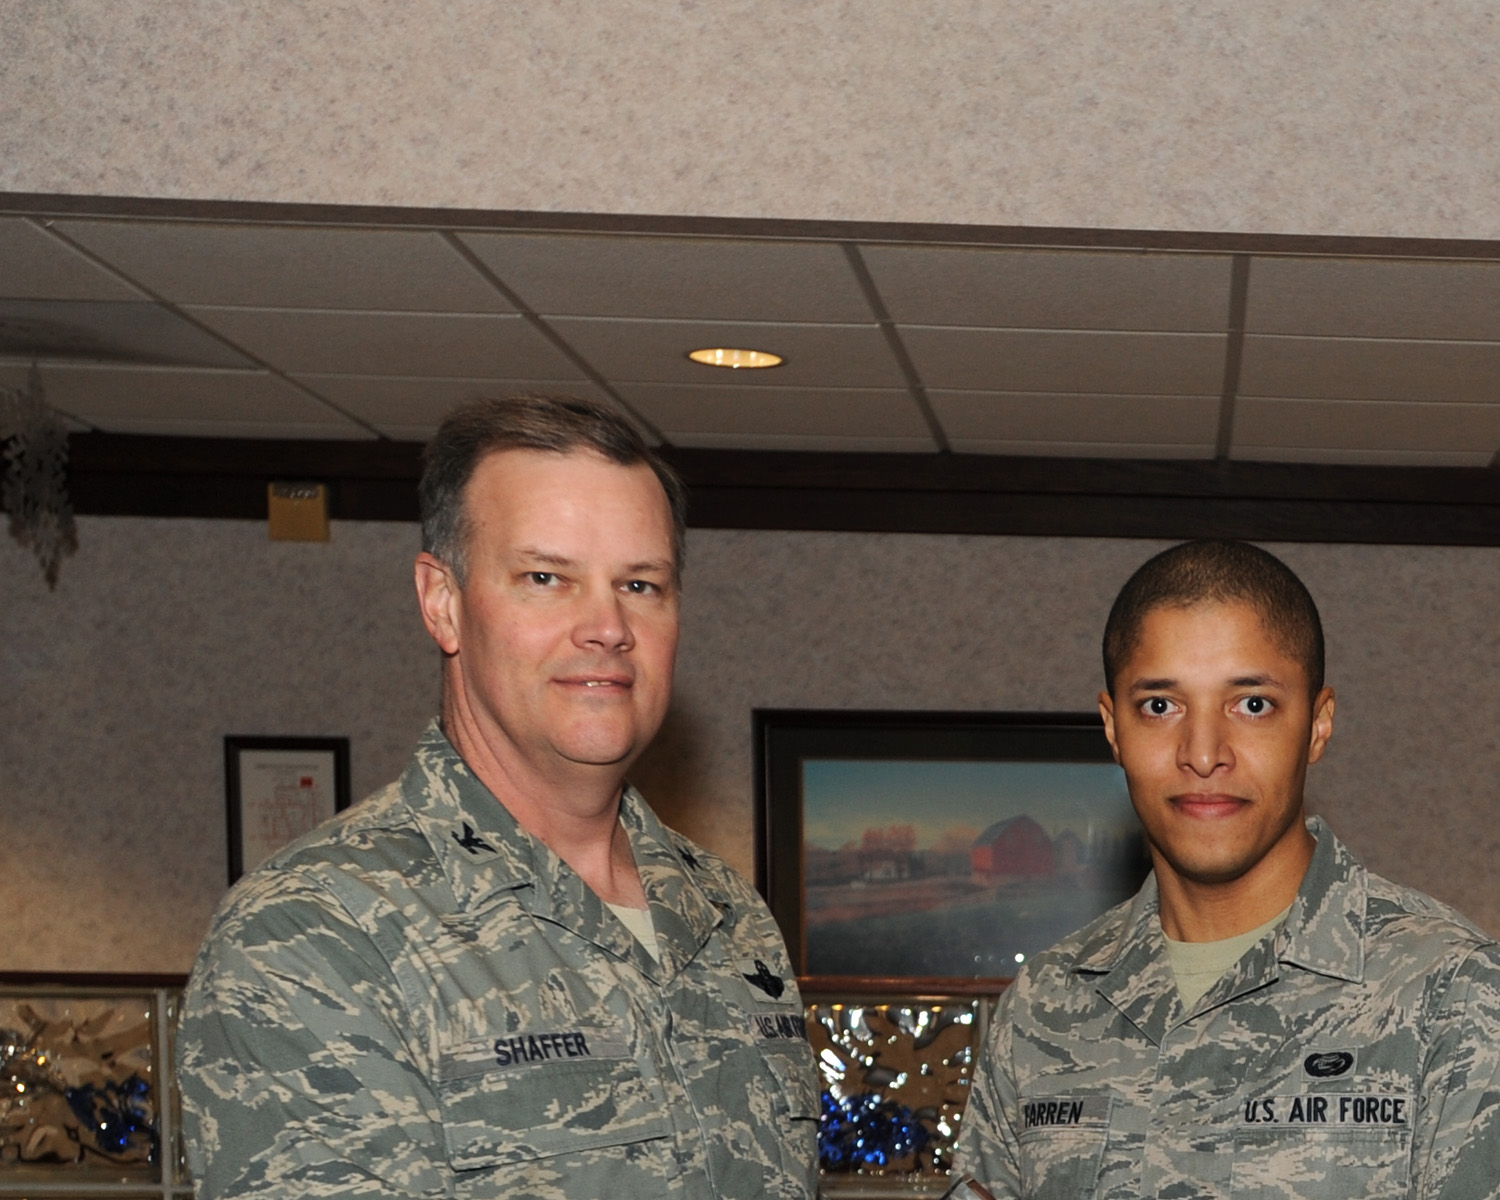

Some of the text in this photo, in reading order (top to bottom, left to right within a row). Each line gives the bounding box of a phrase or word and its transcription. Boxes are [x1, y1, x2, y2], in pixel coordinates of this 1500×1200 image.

[494, 1032, 591, 1066] SHAFFER
[1024, 1101, 1084, 1128] FARREN
[1244, 1096, 1406, 1124] U.S. AIR FORCE
